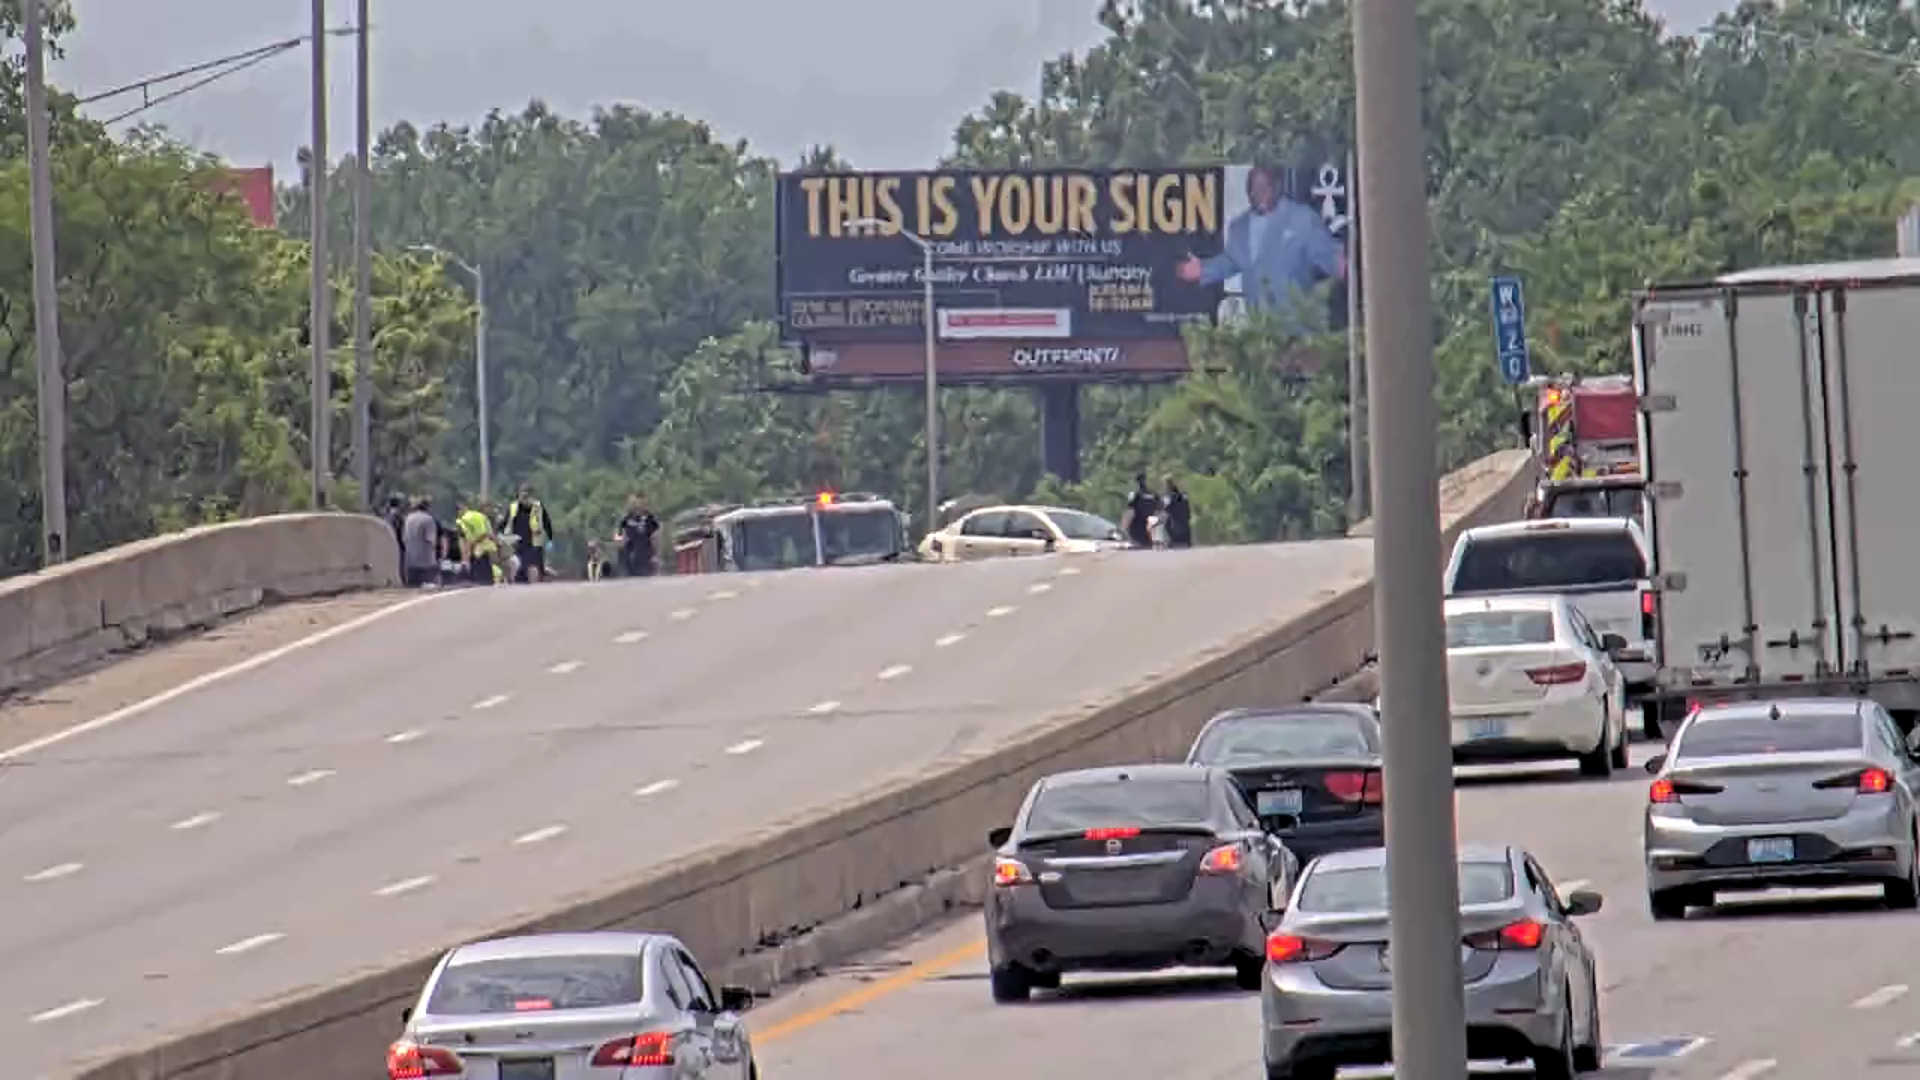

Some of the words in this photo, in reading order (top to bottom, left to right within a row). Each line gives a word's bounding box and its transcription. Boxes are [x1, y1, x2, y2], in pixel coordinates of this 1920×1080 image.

[801, 175, 903, 237] THIS
[917, 176, 958, 235] IS
[971, 174, 1097, 235] YOUR
[1109, 173, 1216, 233] SIGN
